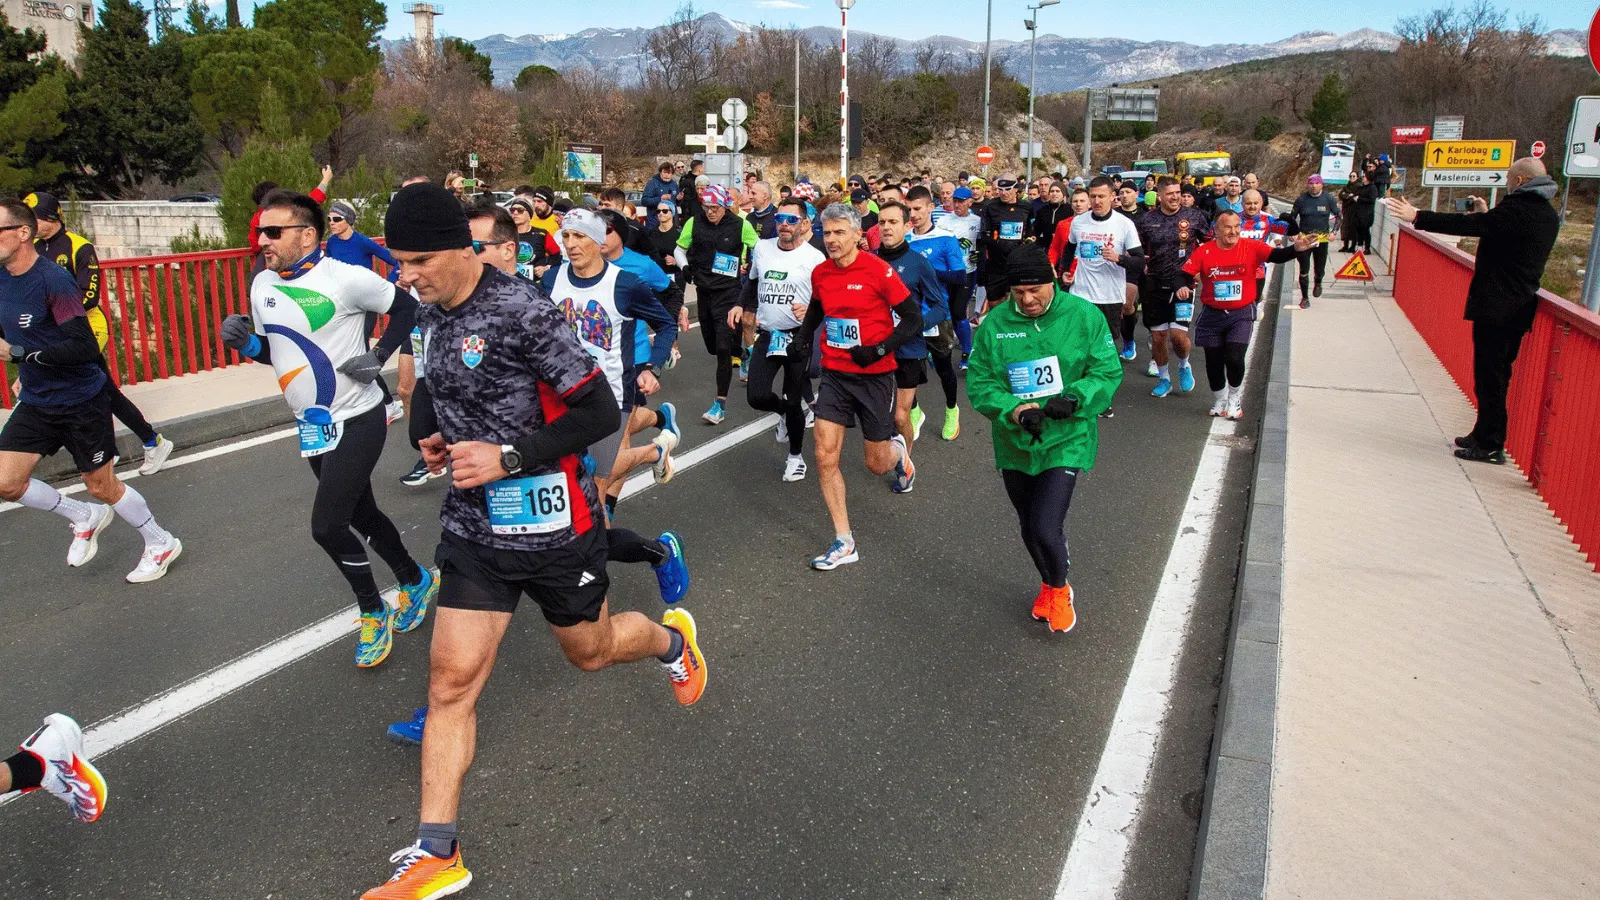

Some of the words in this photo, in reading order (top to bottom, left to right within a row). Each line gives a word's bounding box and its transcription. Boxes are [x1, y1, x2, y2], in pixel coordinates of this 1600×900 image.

[1395, 127, 1425, 135] TOMMY
[1447, 146, 1488, 156] Karlobag
[1447, 156, 1486, 165] Obrovac
[1433, 173, 1481, 181] Maslenica
[1240, 229, 1265, 239] OMMY
[1227, 284, 1241, 295] 118
[839, 325, 858, 340] 148
[1033, 364, 1054, 386] 23
[321, 423, 337, 442] 94
[524, 484, 566, 517] 163
